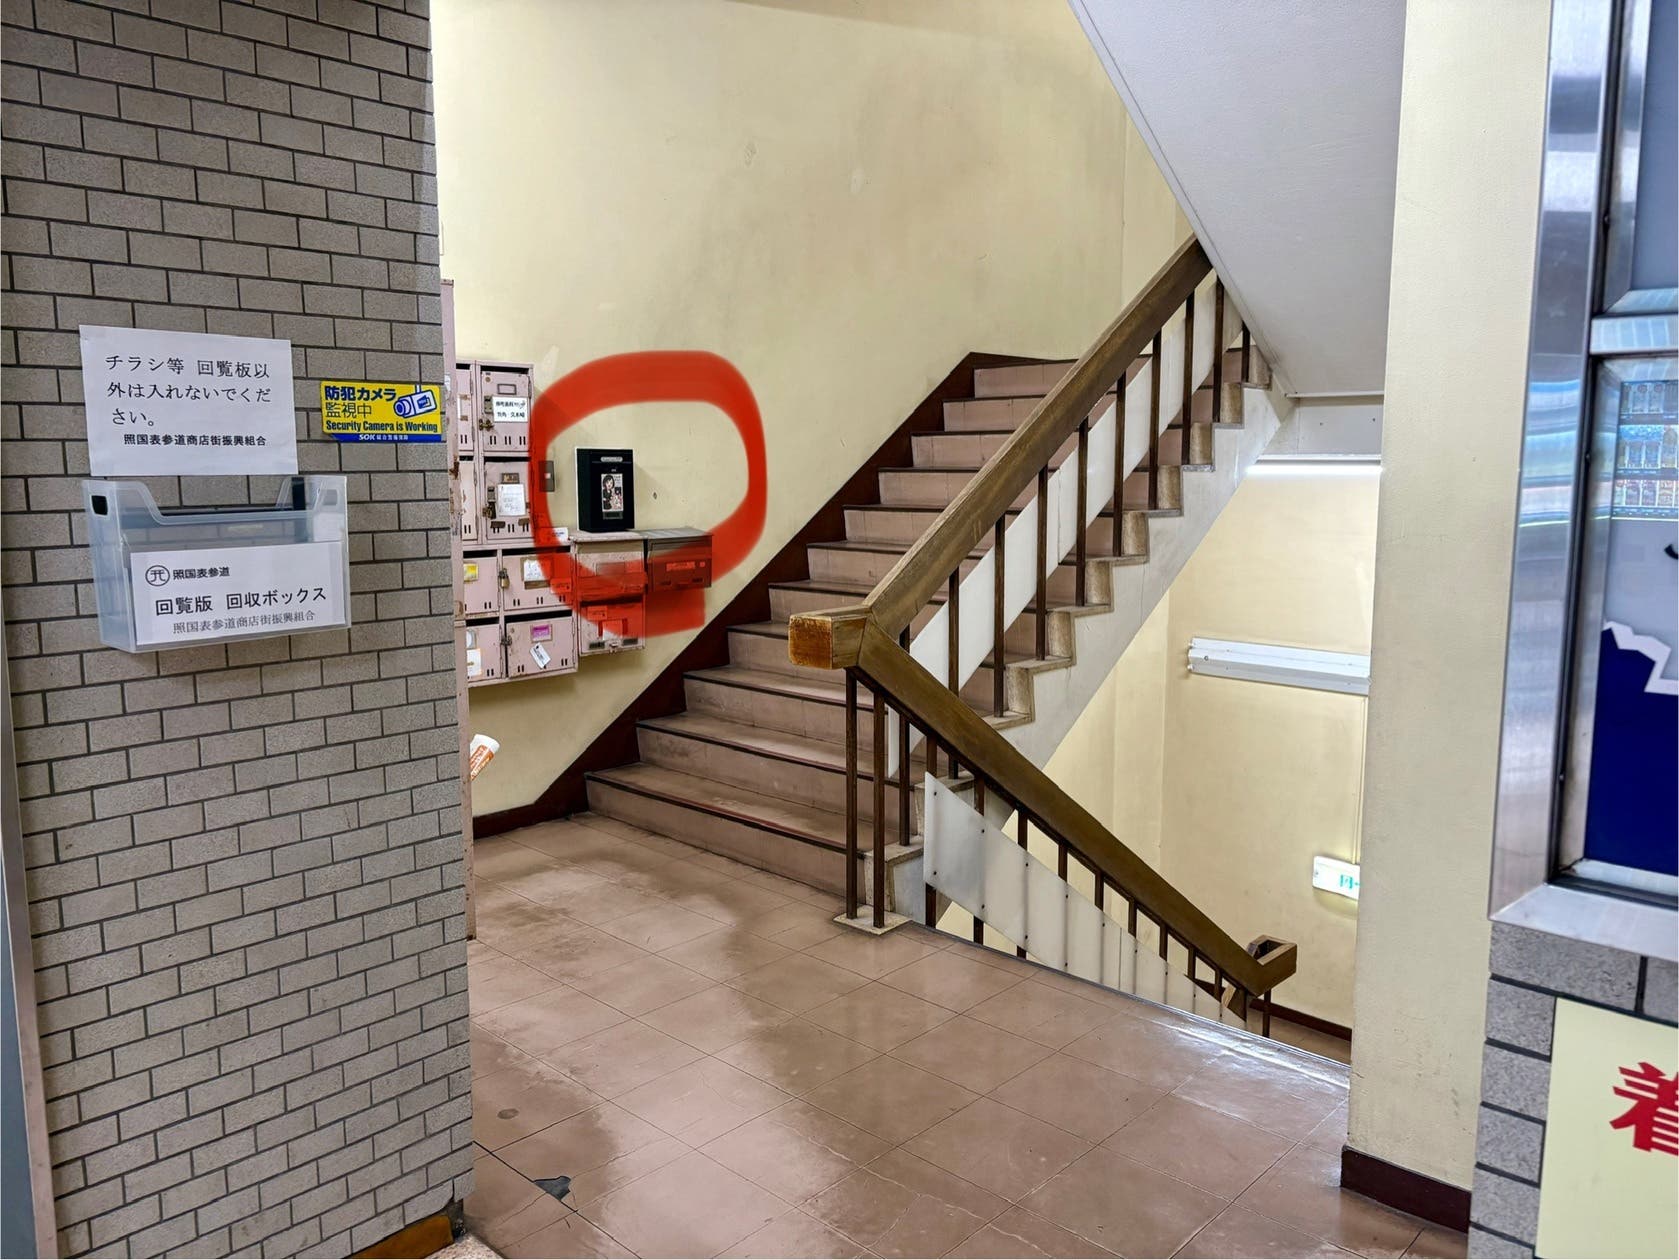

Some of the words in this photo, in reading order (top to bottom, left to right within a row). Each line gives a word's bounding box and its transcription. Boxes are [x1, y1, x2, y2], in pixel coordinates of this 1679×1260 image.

[105, 355, 184, 375] チラシ等
[197, 360, 270, 379] 回覧板以
[106, 382, 272, 403] 外は入れないでくだ
[324, 385, 396, 400] 防犯カメラ
[112, 408, 154, 427] さい。
[326, 402, 371, 418] 監視中
[326, 420, 361, 432] Security
[363, 421, 394, 432] Camera
[396, 422, 403, 431] is
[405, 422, 438, 432] Working
[123, 434, 267, 446] 照国表参道商店街振興組合
[173, 567, 230, 580] 照国表参道
[156, 596, 213, 616] 回覧版
[226, 588, 327, 610] 回収ボックス
[173, 610, 316, 634] 照国表参道商店街振興組合
